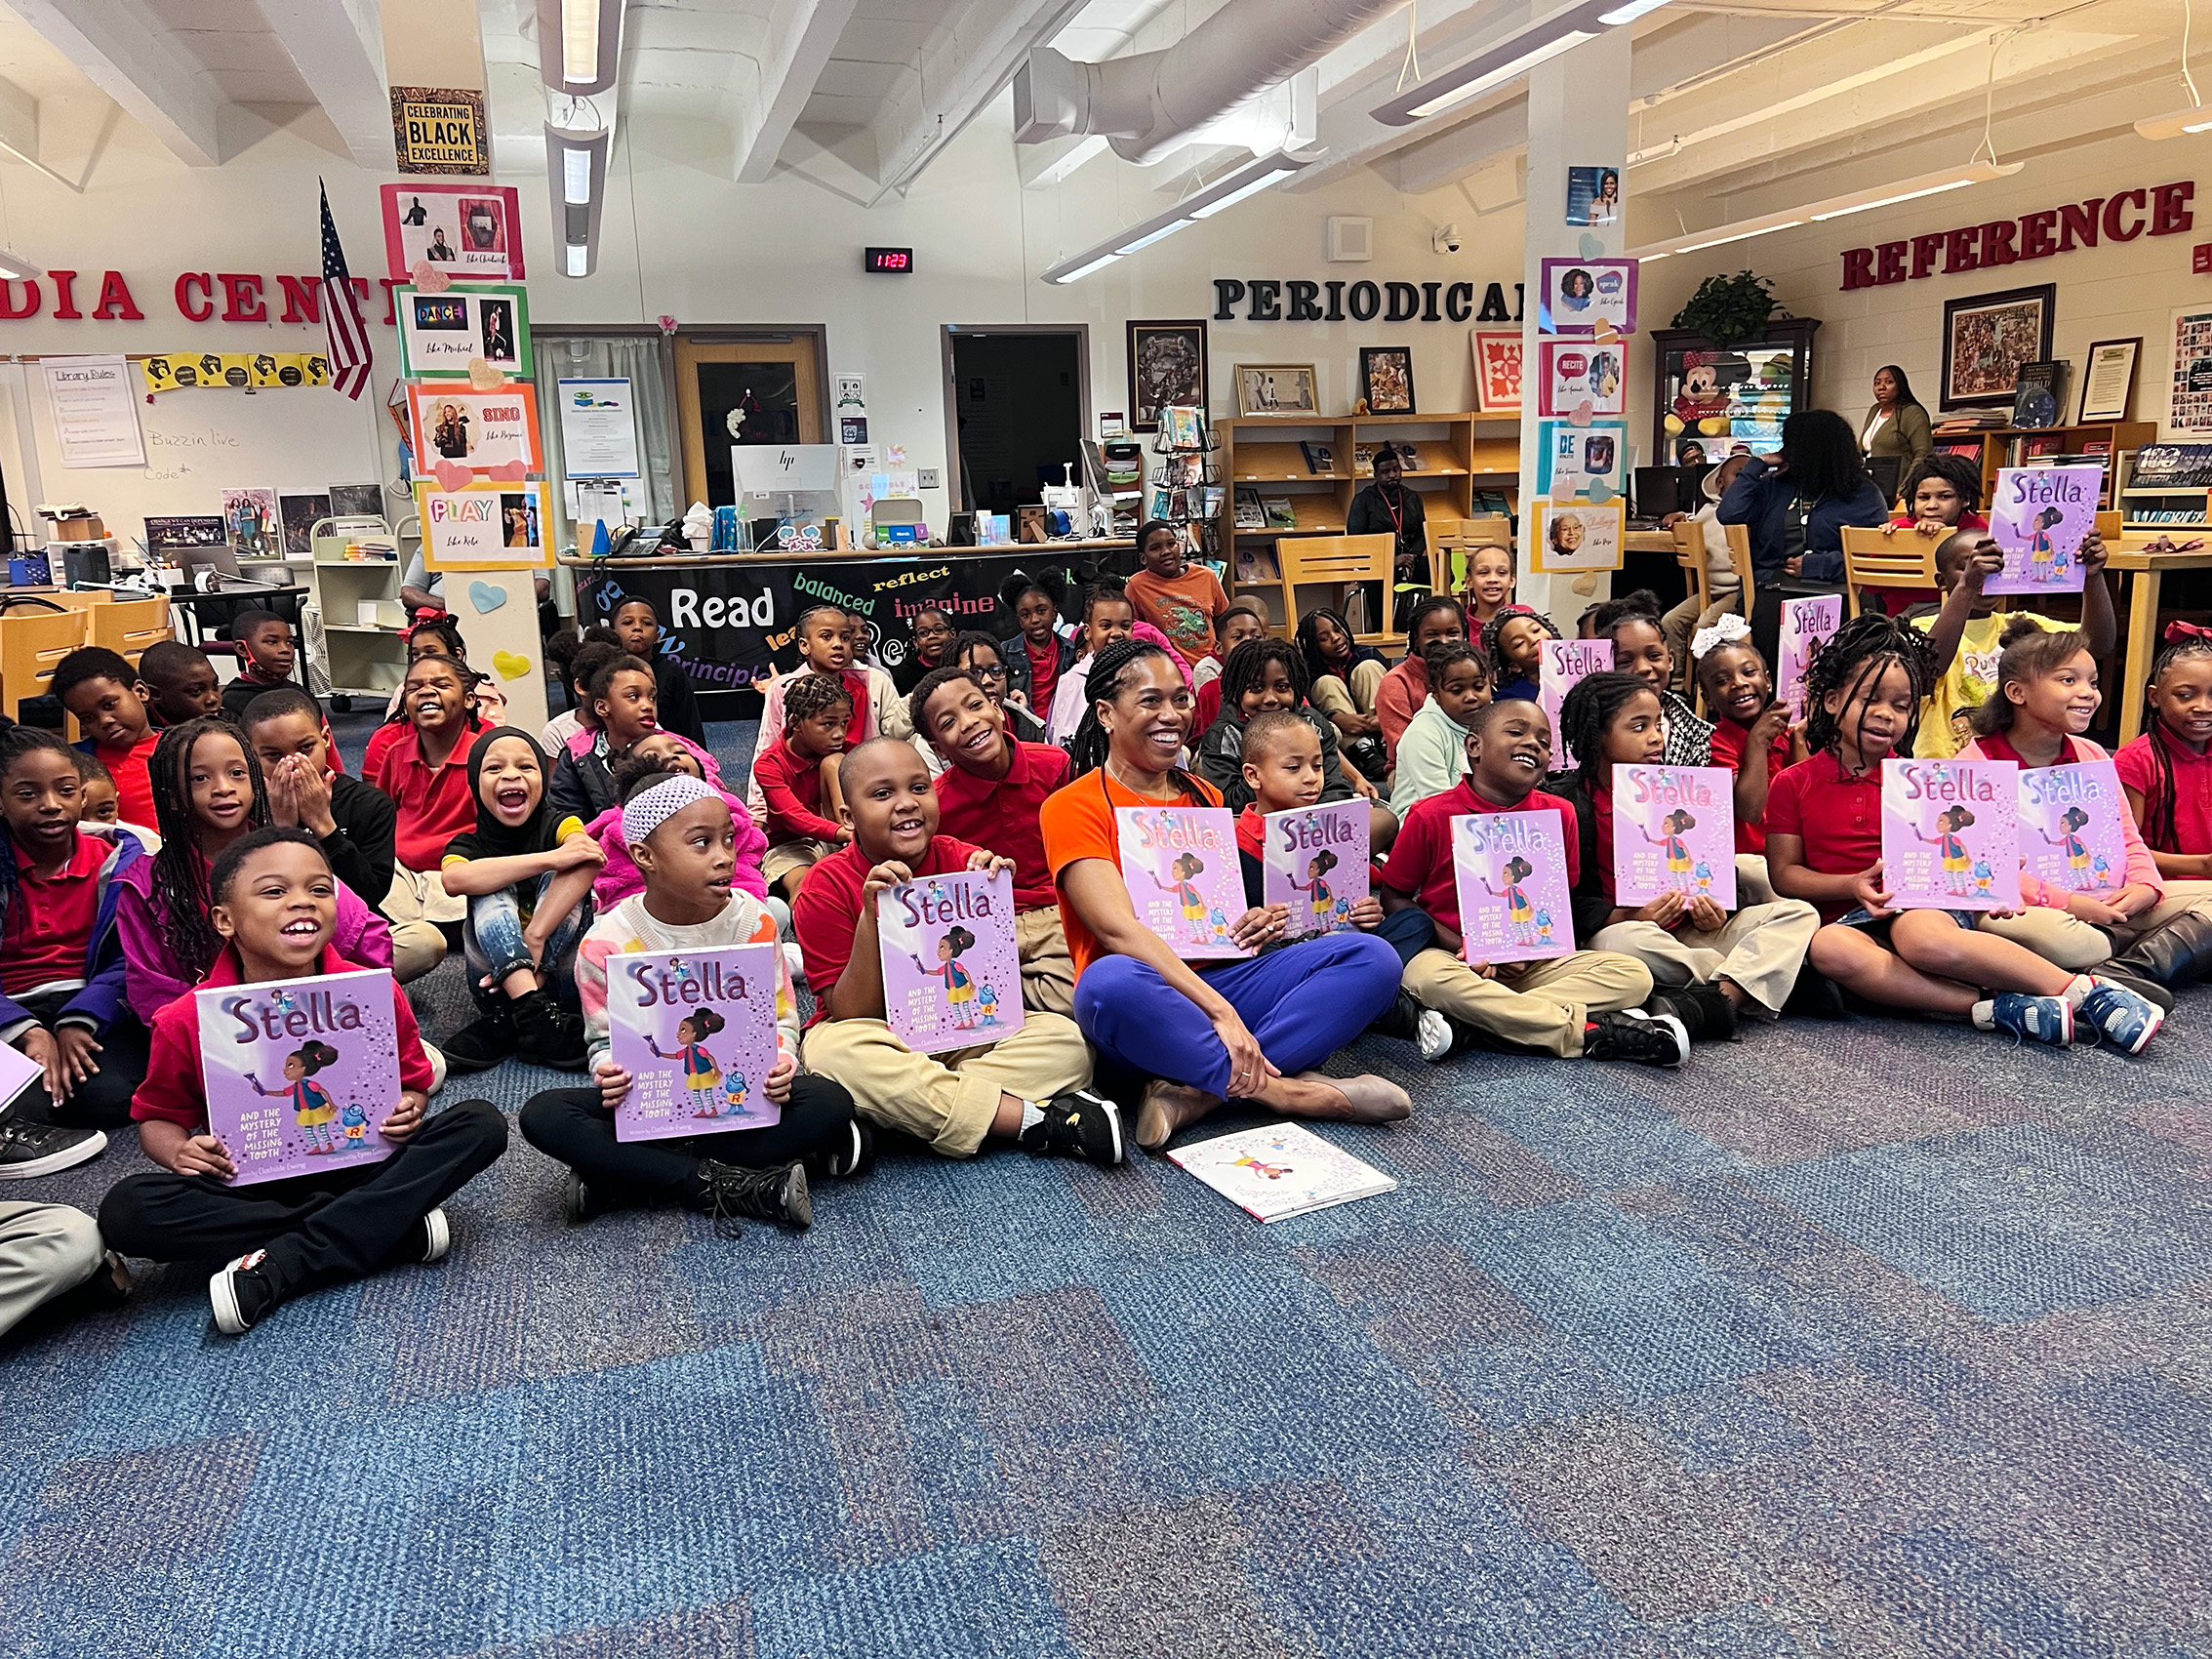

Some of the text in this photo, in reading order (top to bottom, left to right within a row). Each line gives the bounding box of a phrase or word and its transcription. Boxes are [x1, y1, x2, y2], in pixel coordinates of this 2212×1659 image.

[407, 105, 470, 119] CELEBRATING
[409, 121, 472, 145] BLACK
[412, 147, 474, 161] EXCELLENCE
[1839, 181, 2194, 291] REFERENCE
[877, 254, 906, 268] 11:23
[175, 271, 408, 325] CEN
[420, 306, 461, 320] DANCE
[442, 343, 473, 353] Michael
[1562, 360, 1584, 370] RECITE
[55, 370, 115, 383] Library Rules
[482, 407, 521, 422] SING
[210, 428, 240, 447] live
[2013, 474, 2082, 504] Stella
[430, 499, 493, 523] PLAY
[872, 565, 950, 592] reflect
[793, 572, 875, 616] balanced
[670, 587, 775, 628] Read
[1794, 606, 1831, 634] Stella
[1555, 646, 1602, 675] Stella
[1633, 771, 1712, 806] Stella
[1906, 766, 1995, 801] Stella
[2029, 771, 2102, 806] Stella
[1137, 814, 1218, 849] Stella
[1284, 813, 1353, 853] Stella
[1470, 819, 1547, 855] Stella
[902, 882, 993, 928] Stella
[636, 961, 749, 1007] Stella
[907, 986, 937, 997] AND THE
[907, 994, 937, 1006] MYSTERY
[912, 1004, 936, 1015] OF THE
[985, 1005, 992, 1014] R
[232, 991, 365, 1043] Stella
[910, 1012, 938, 1025] MISSING
[914, 1023, 936, 1033] TOOTH
[658, 1070, 673, 1078] THE
[637, 1079, 674, 1090] MYSTERY
[642, 1089, 670, 1099] OF THE
[731, 1094, 741, 1103] R
[640, 1099, 673, 1109] MISSING
[240, 1108, 281, 1122] AND THE
[645, 1109, 670, 1118] TOOTH
[240, 1117, 282, 1132] MYSTERY
[246, 1129, 279, 1142] OF THE
[349, 1127, 360, 1137] R
[244, 1137, 283, 1152] MISSING
[250, 1148, 280, 1160] TOOTH
